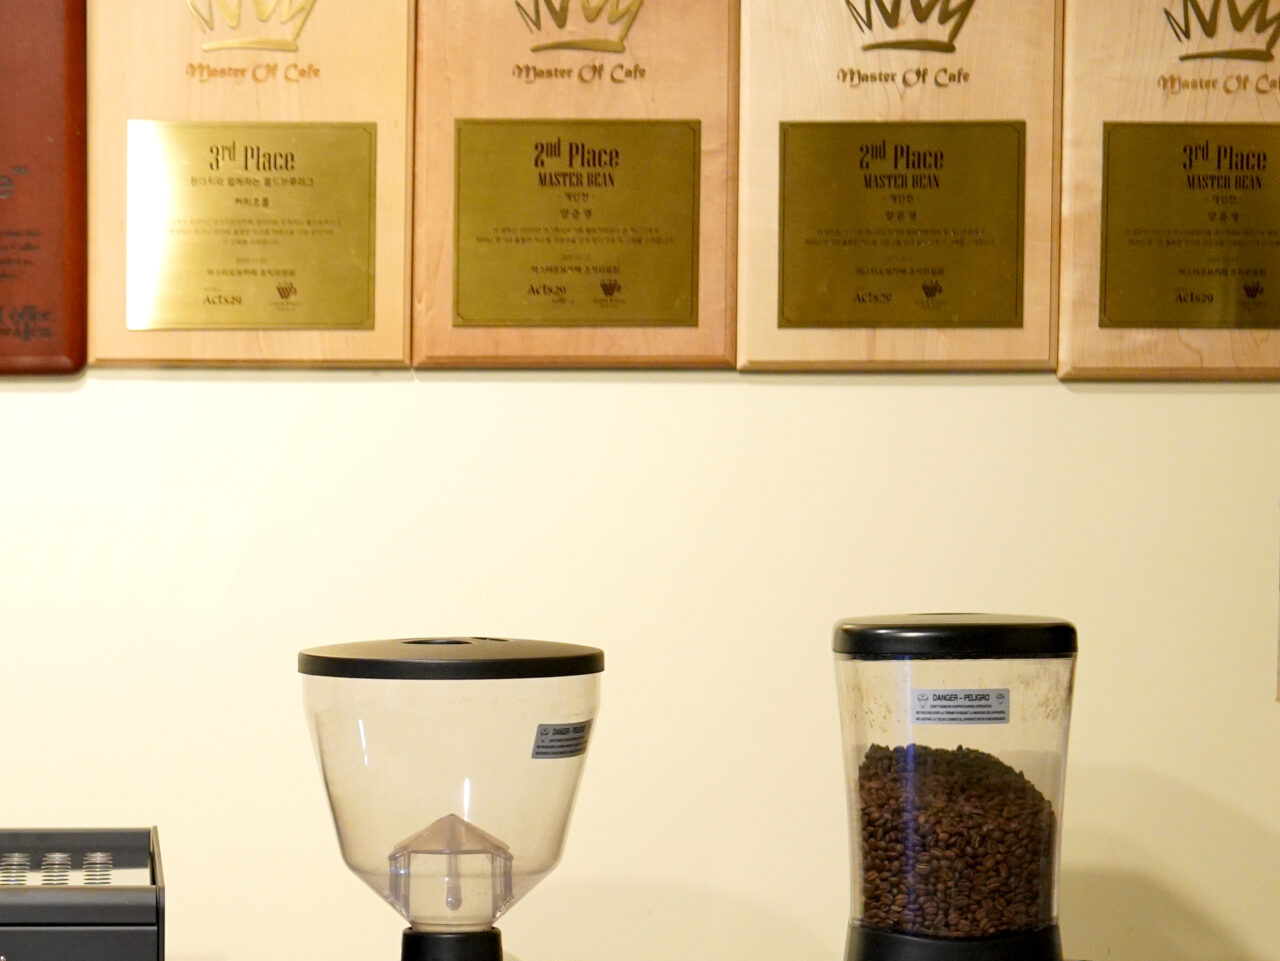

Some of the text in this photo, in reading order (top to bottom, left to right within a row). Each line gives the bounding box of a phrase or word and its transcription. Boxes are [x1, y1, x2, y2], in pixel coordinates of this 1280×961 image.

[512, 63, 646, 84] Master Of Cafe
[837, 67, 970, 88] Master Of Cafe
[1157, 73, 1280, 95] Master Of Ca
[209, 140, 295, 171] 3rd Place
[534, 136, 619, 168] 2nd Place
[859, 139, 944, 170] 2nd Place
[1182, 139, 1267, 171] 3rd Place
[538, 172, 615, 188] MASTER BEAN
[863, 174, 940, 189] MASTER BEAN
[1186, 175, 1263, 191] MASTER BEAN
[963, 693, 990, 701] PELIGRO
